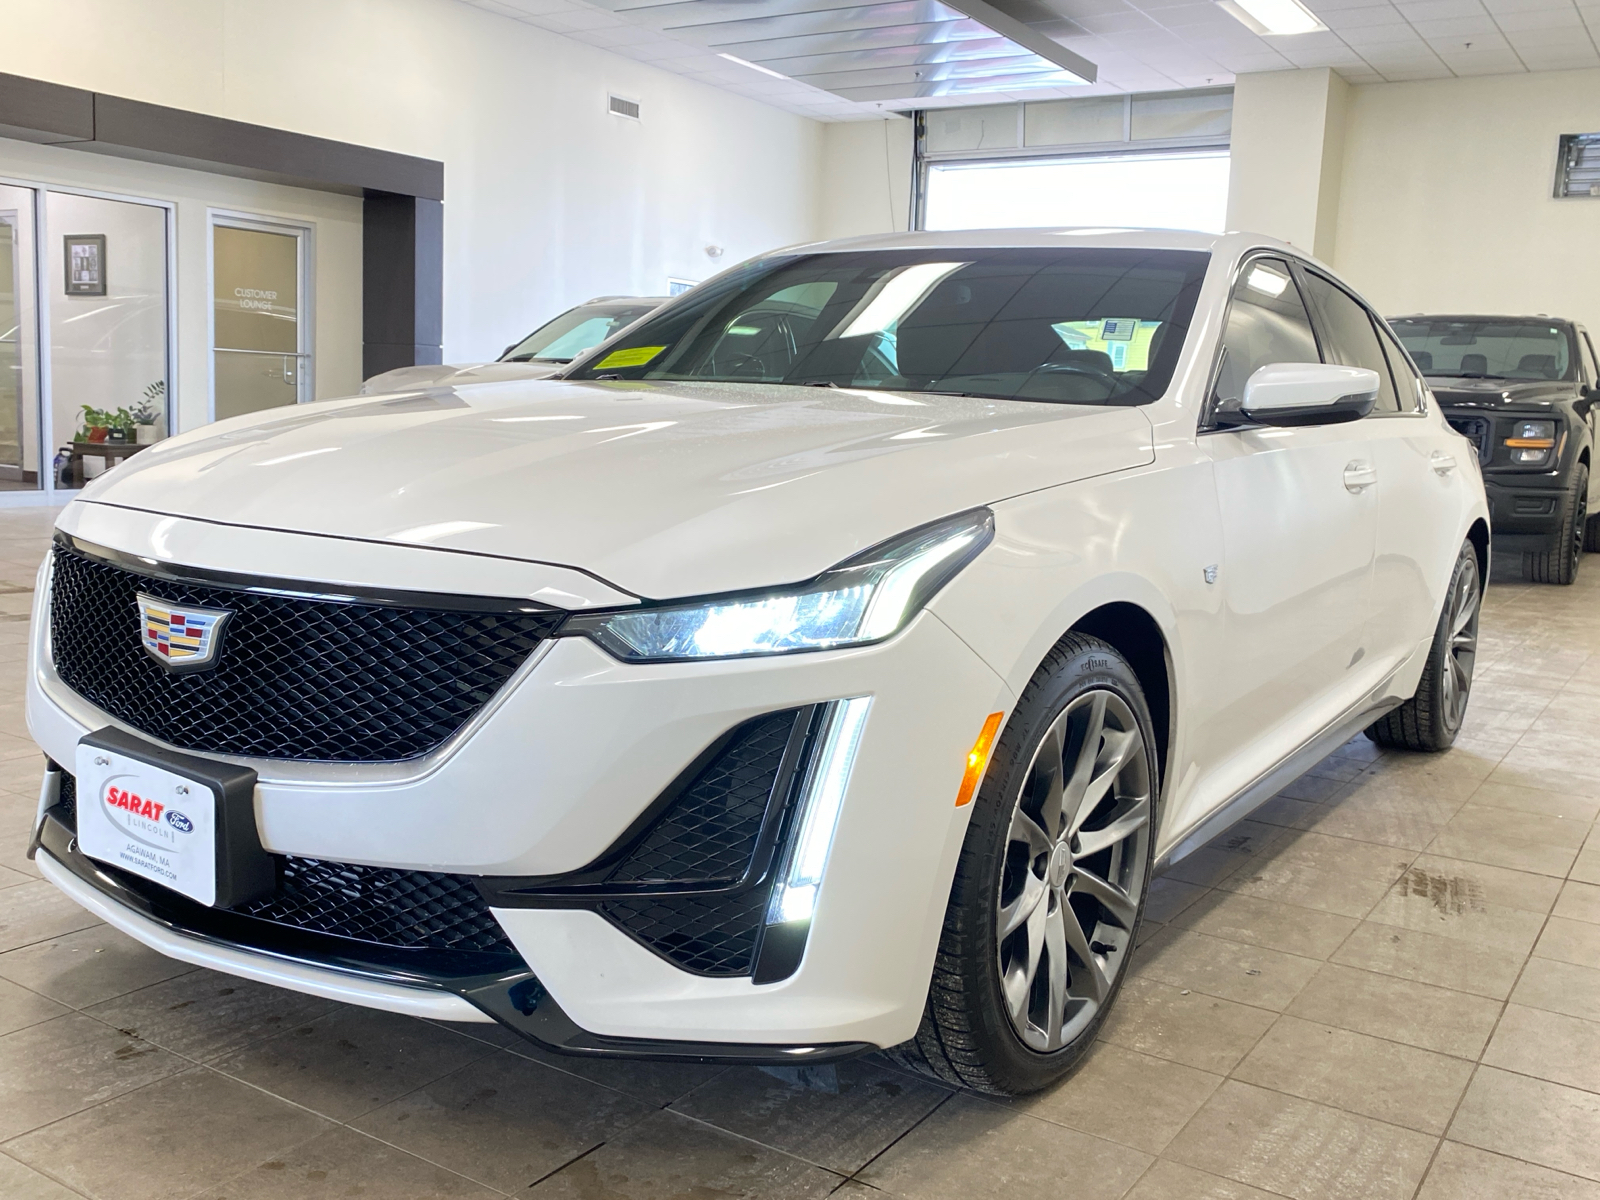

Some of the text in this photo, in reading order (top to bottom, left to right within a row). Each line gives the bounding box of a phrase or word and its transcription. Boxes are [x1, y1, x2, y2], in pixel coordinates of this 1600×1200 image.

[234, 287, 277, 300] CUSTOMER
[240, 299, 272, 310] LOUNGE
[106, 786, 165, 823] SARAT
[133, 818, 169, 838] LINCOLN
[169, 812, 190, 832] Ford
[126, 843, 171, 867] AGAWAM, MA
[119, 851, 178, 881] WWW.SARATFORD.COM
